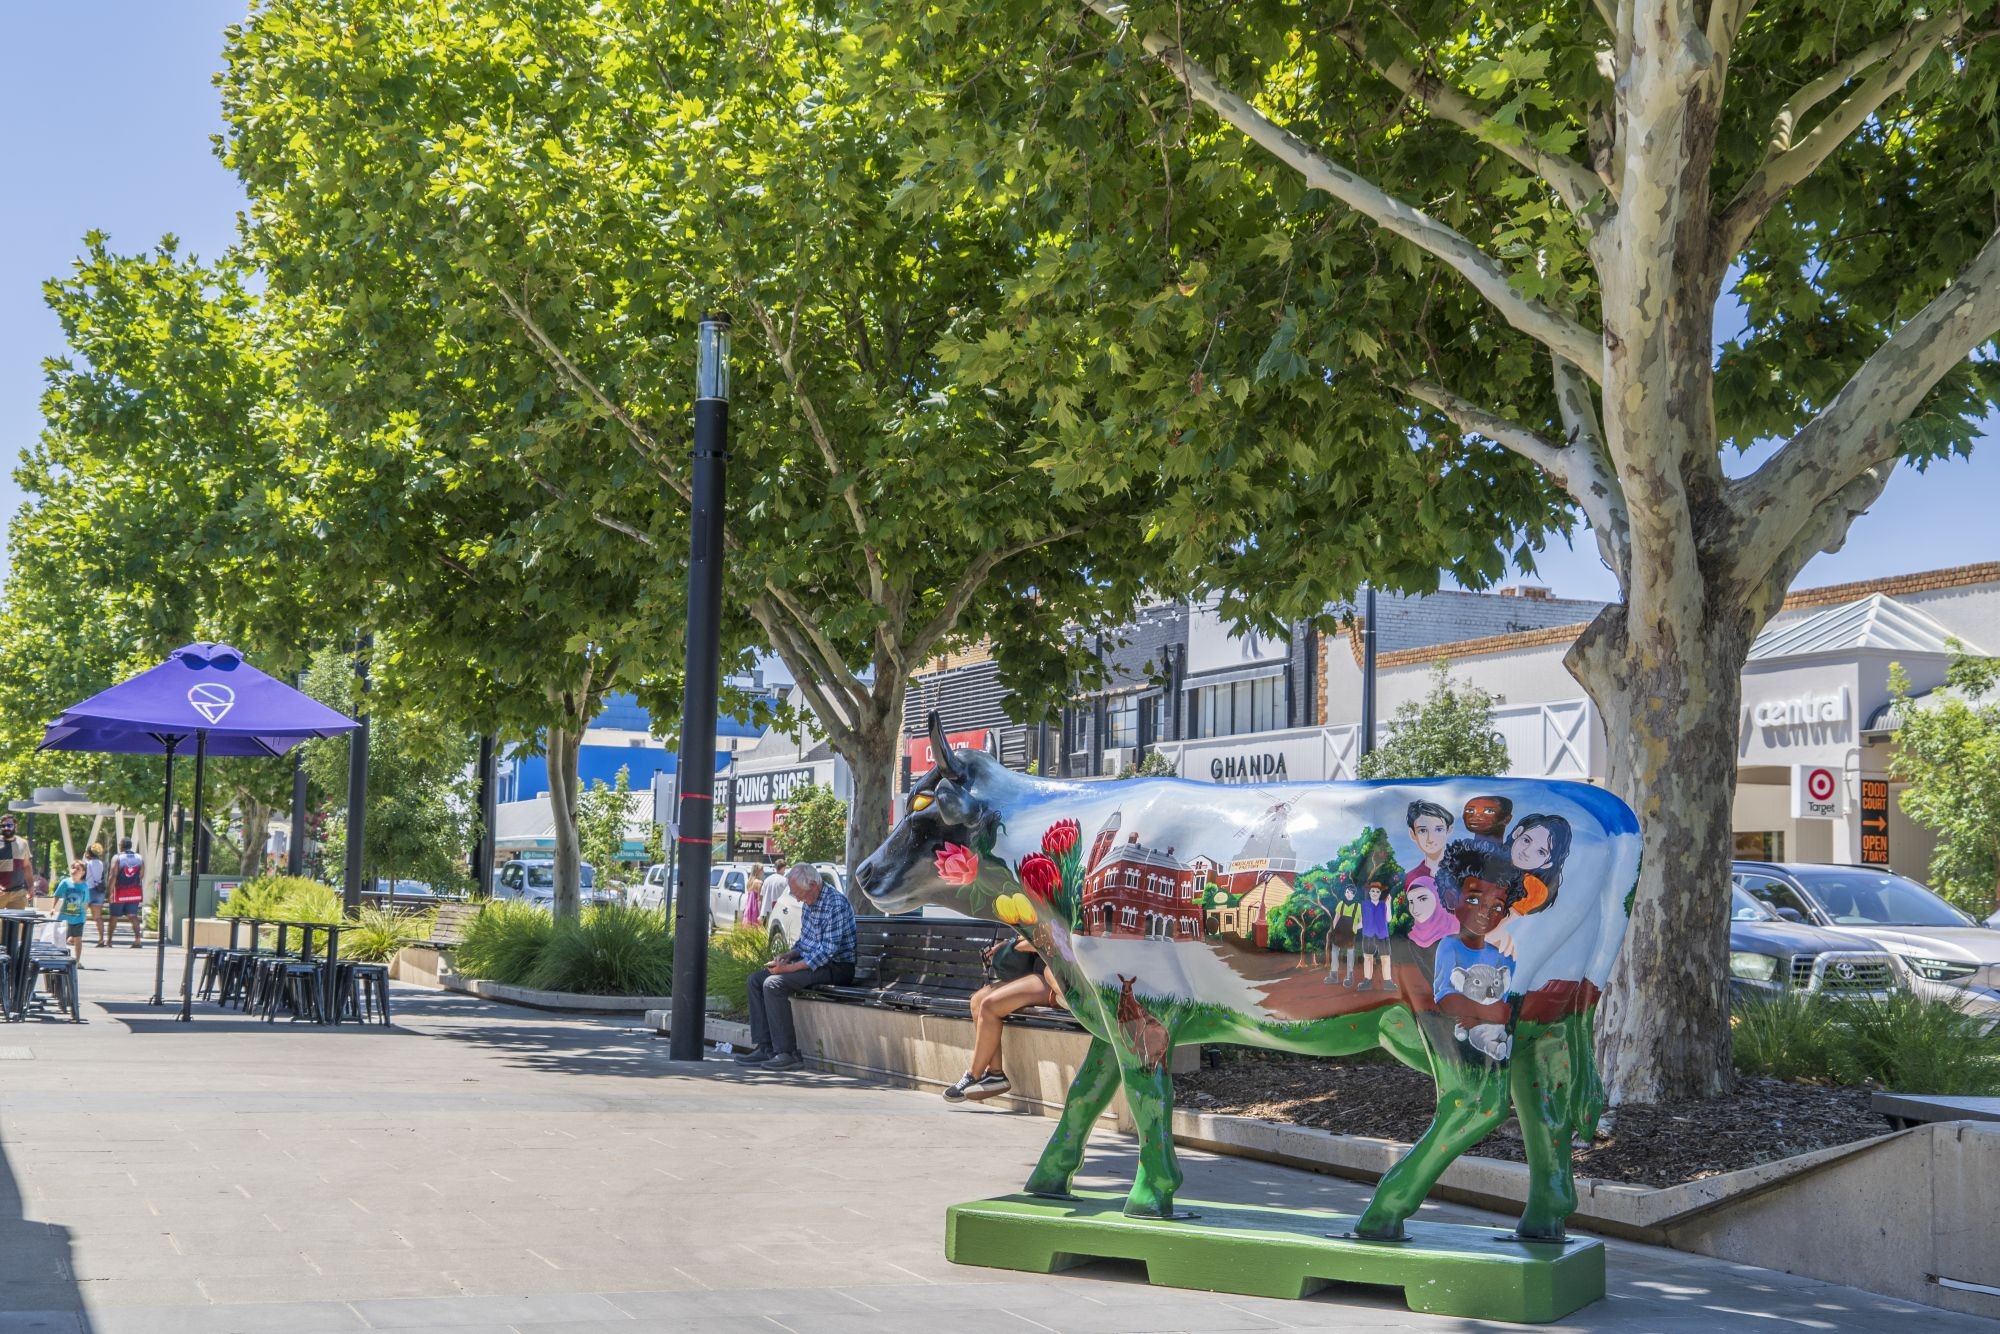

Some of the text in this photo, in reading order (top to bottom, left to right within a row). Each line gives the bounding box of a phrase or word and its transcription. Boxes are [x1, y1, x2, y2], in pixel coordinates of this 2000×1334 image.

[1754, 686, 1849, 728] central
[1211, 752, 1287, 779] GHANDA
[736, 775, 769, 803] OUNG
[1862, 782, 1886, 797] FOOD
[1808, 801, 1835, 815] Target
[1862, 797, 1886, 810] COURT
[1862, 835, 1887, 850] OPEN
[1863, 851, 1887, 862] 7 DAYS
